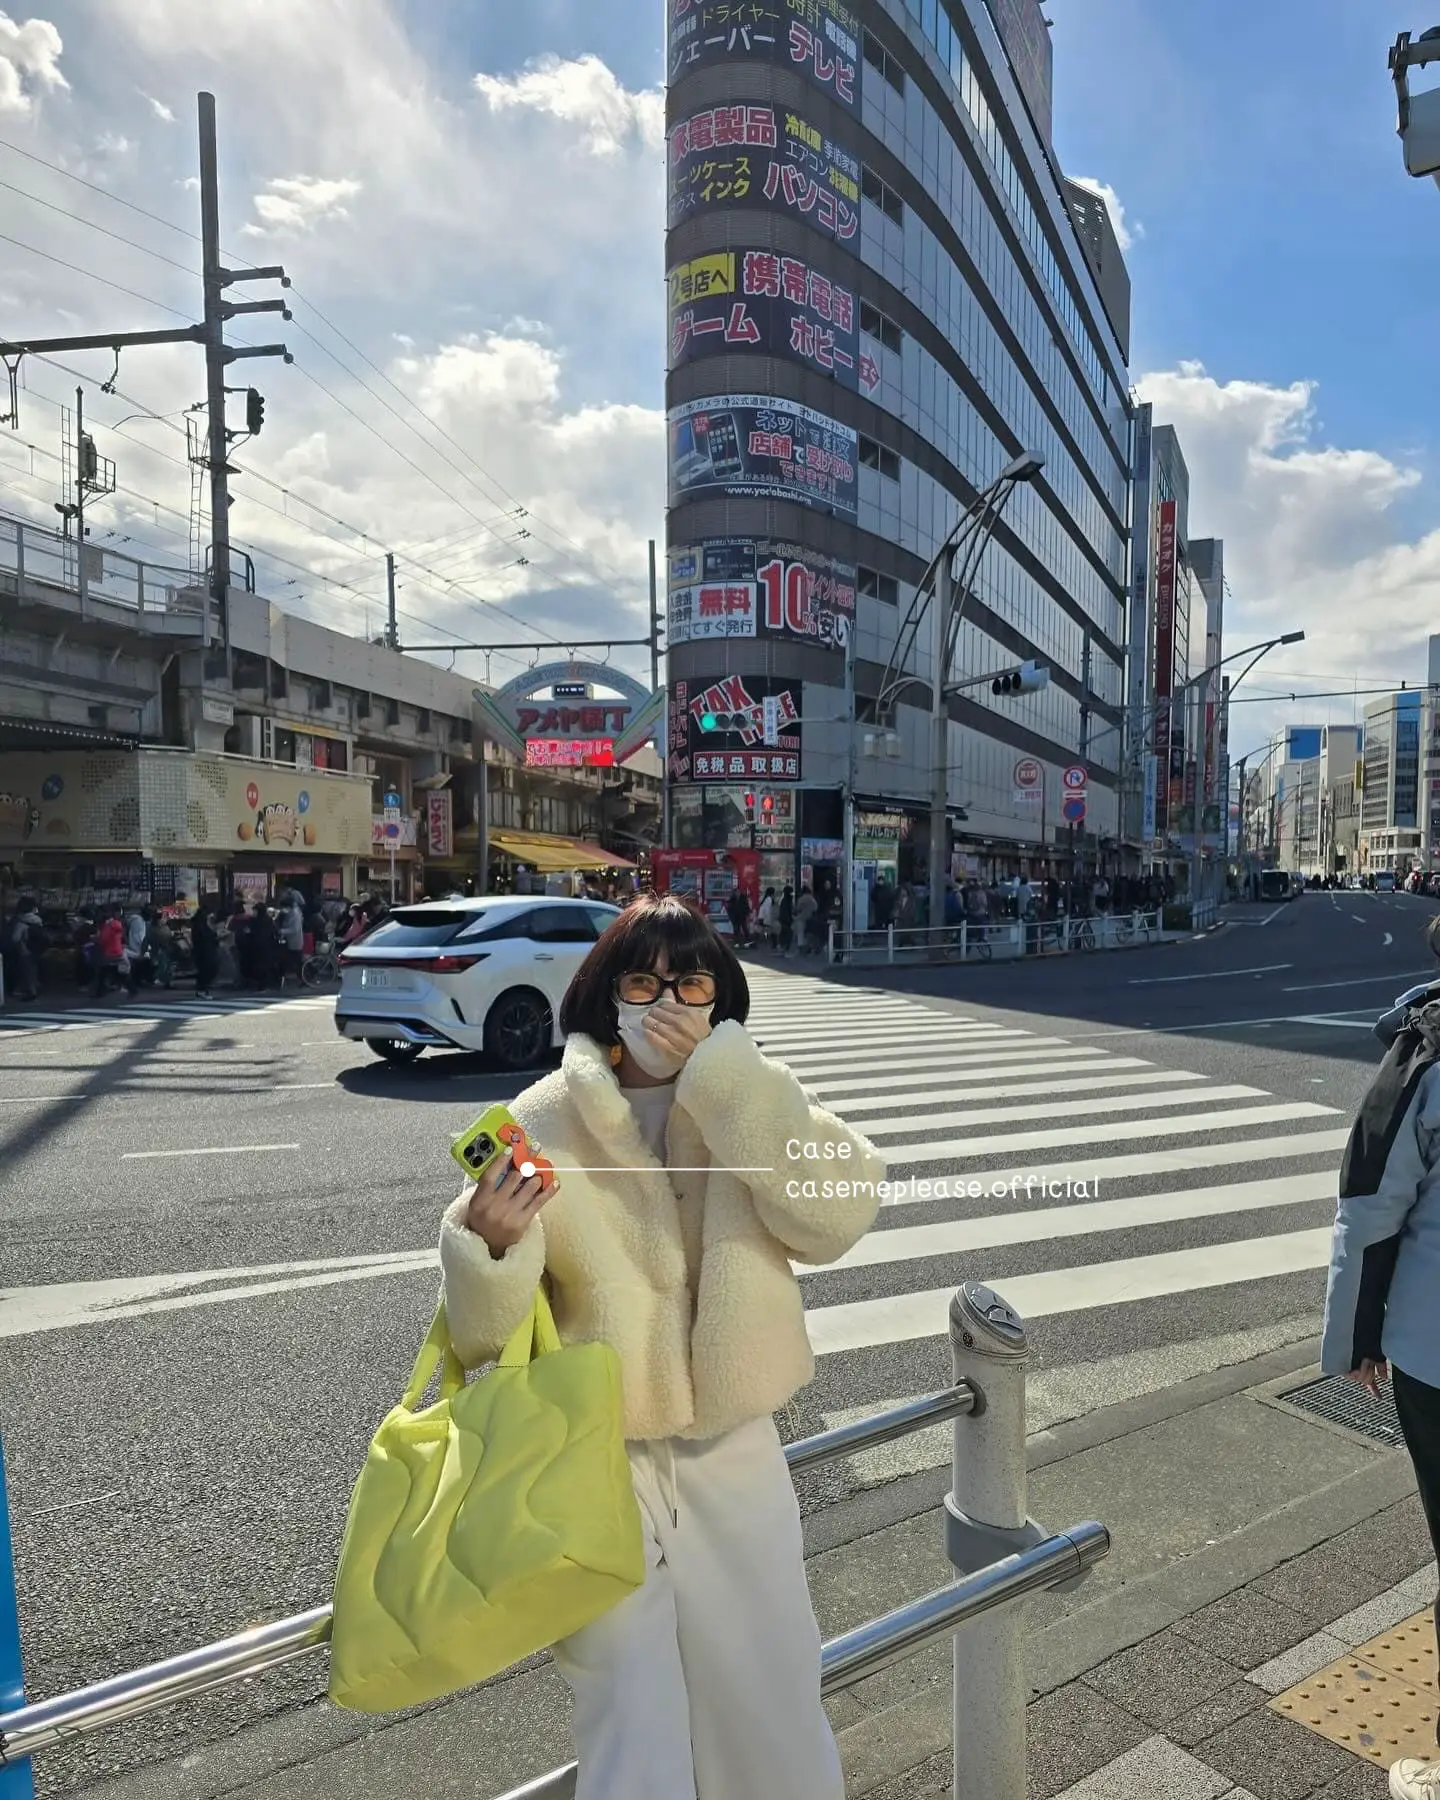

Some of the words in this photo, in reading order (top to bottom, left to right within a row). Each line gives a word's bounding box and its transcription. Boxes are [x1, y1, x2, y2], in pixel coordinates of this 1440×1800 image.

[789, 20, 855, 105] テレビ
[700, 178, 750, 202] インク
[763, 161, 858, 238] パソコン
[743, 251, 853, 334] 携帯電話
[672, 303, 760, 359] ゲーム
[790, 315, 853, 369] ホビー
[698, 586, 750, 616] 無料
[695, 755, 797, 775] 免税品取扱店
